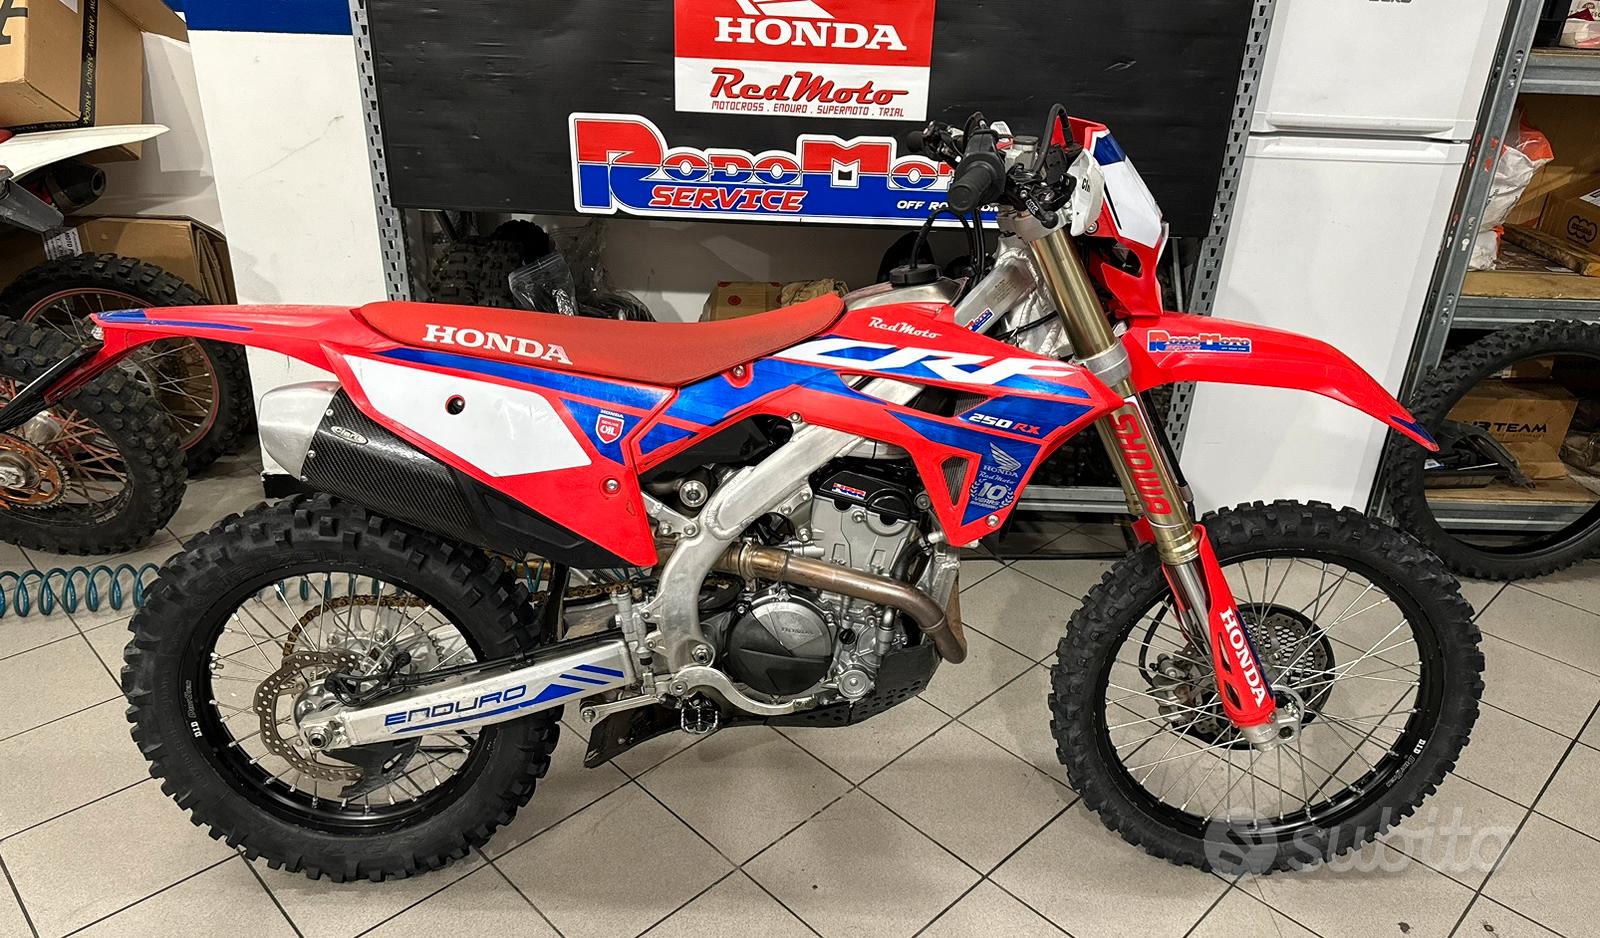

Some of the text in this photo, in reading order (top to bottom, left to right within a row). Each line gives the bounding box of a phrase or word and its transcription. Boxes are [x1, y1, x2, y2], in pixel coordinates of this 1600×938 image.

[88, 16, 97, 50] ARROW
[714, 16, 908, 51] HONDA
[85, 53, 94, 88] ARROW
[710, 67, 909, 105] RedMoto
[711, 100, 905, 117] MOTOCROSS ENDURO SUPERMOTO TRIAL
[649, 186, 809, 212] SERVICE
[896, 200, 926, 210] OFF
[868, 315, 943, 340] RedMoto
[422, 324, 573, 365] HONDA
[772, 338, 1078, 385] CRF
[600, 409, 625, 419] HONDA
[968, 413, 1041, 435] 250 RX
[600, 424, 618, 437] OIL
[1495, 423, 1548, 433] TEAM
[982, 465, 1019, 478] HONDA
[1109, 413, 1173, 515] SHOWA
[977, 482, 1008, 501] 10
[1219, 606, 1266, 708] HONDA
[384, 684, 527, 727] ENDURO
[190, 721, 203, 737] DID
[1413, 738, 1427, 755] DID
